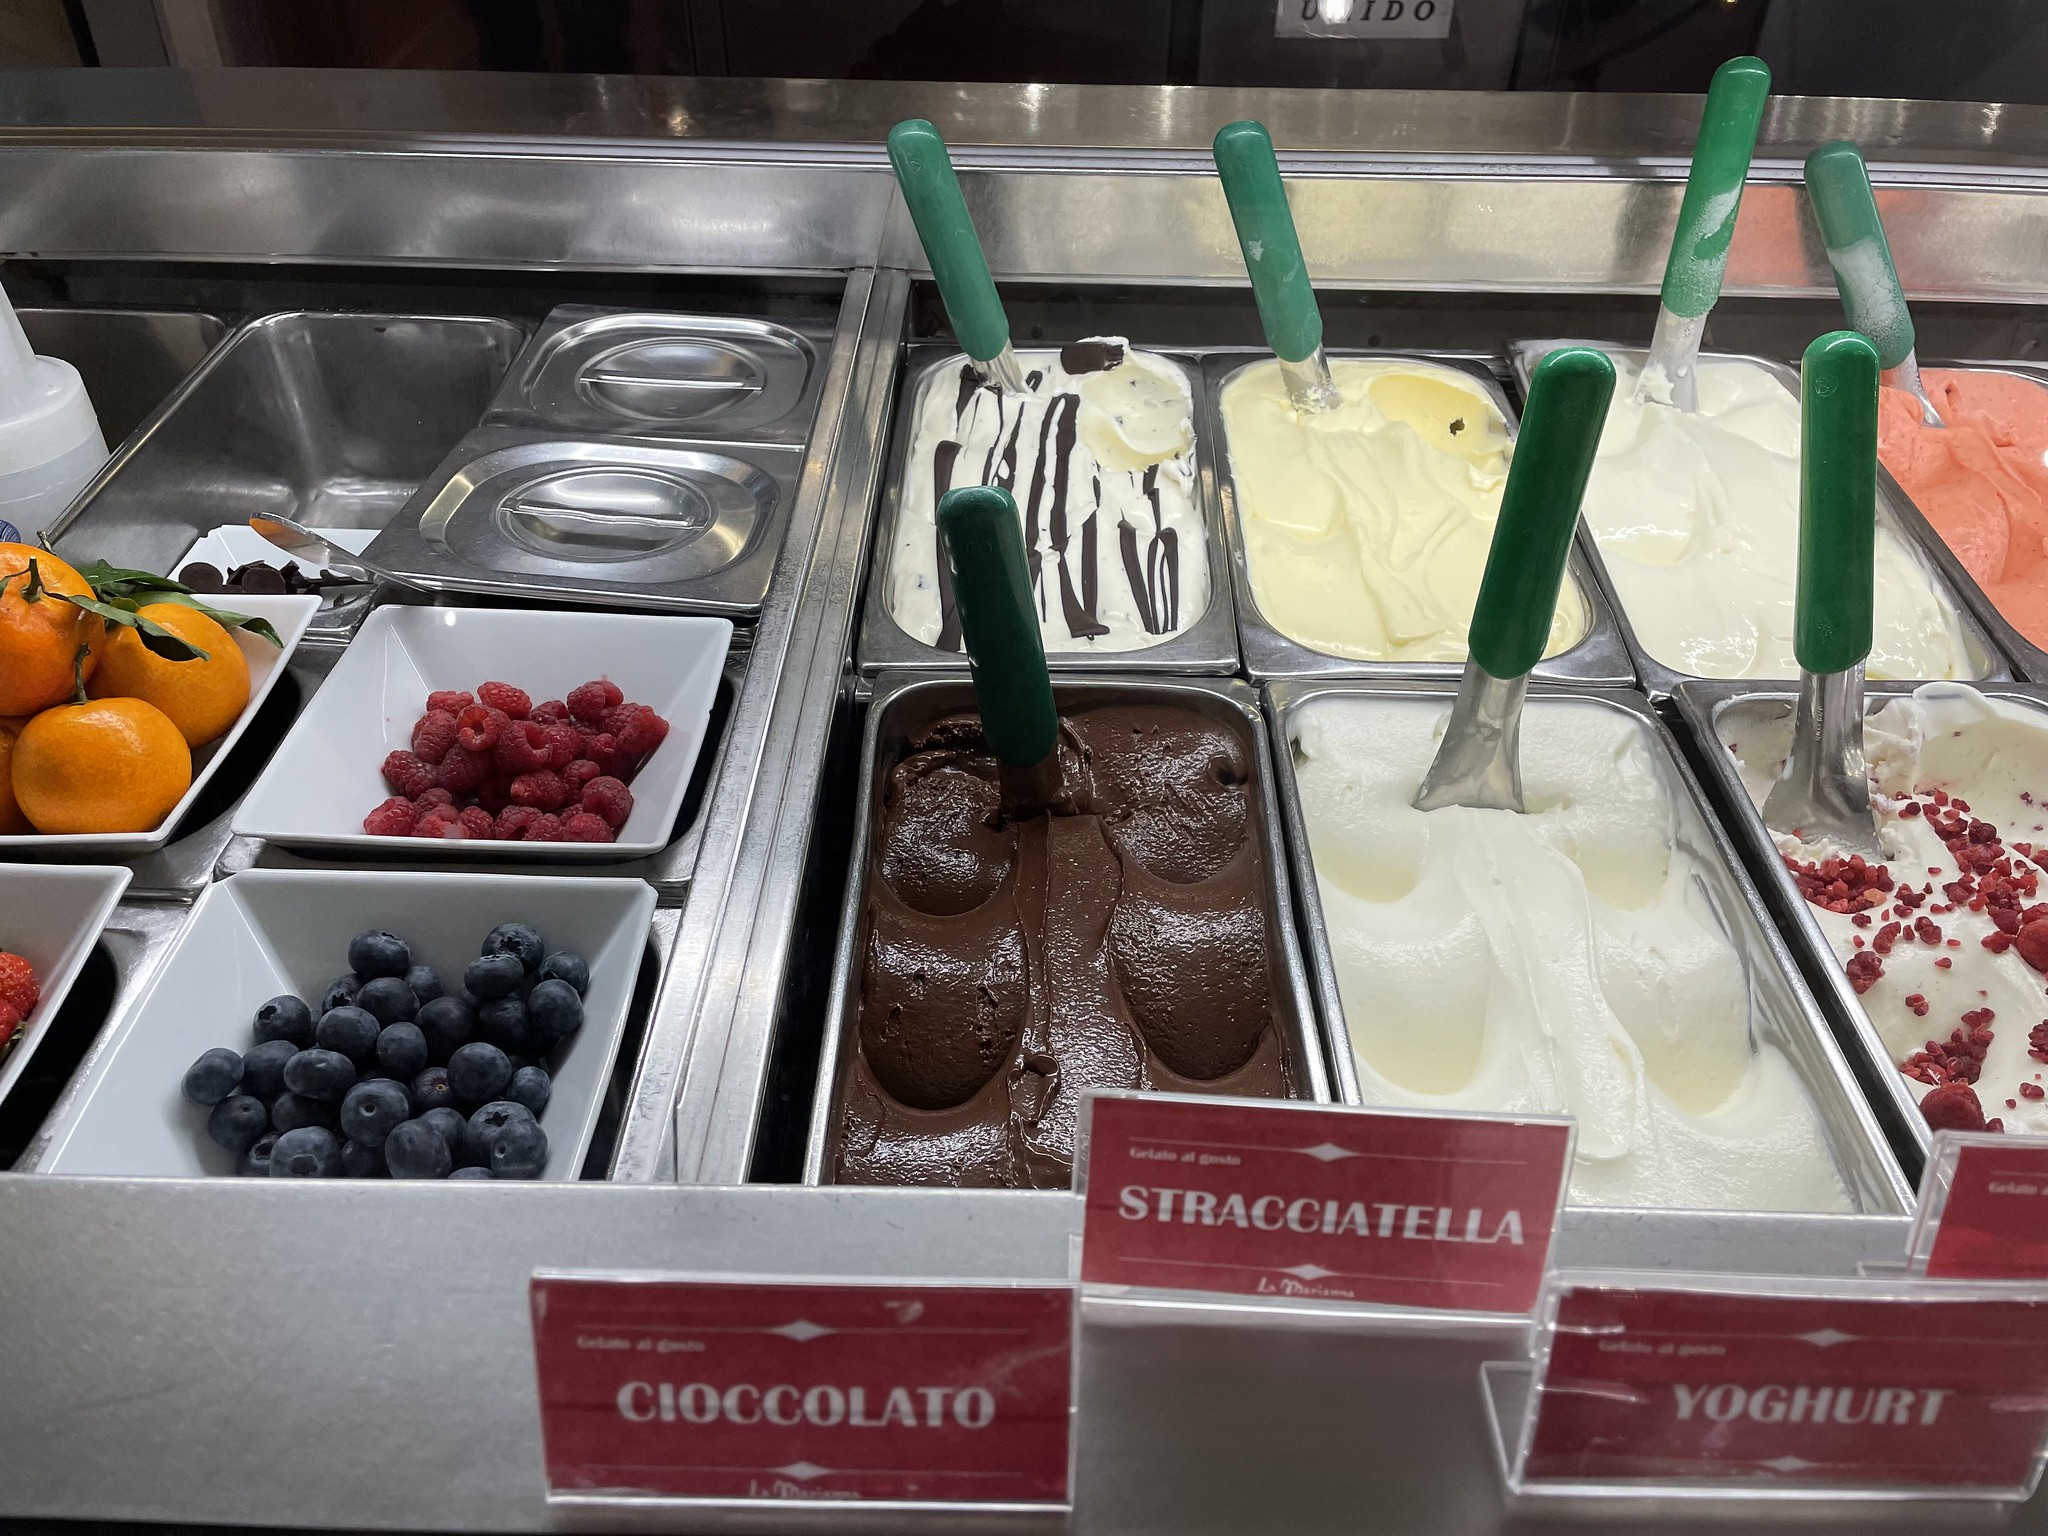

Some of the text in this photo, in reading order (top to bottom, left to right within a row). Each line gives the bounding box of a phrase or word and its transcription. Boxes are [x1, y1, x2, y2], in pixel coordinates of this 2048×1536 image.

[1301, 0, 1436, 21] UIDO
[1129, 1146, 1242, 1166] Gelato al gusto
[1118, 1185, 1525, 1245] STRACCIATELLA
[616, 1381, 996, 1429] CIOCCOLATO
[1673, 1383, 1957, 1426] YOGHURT
